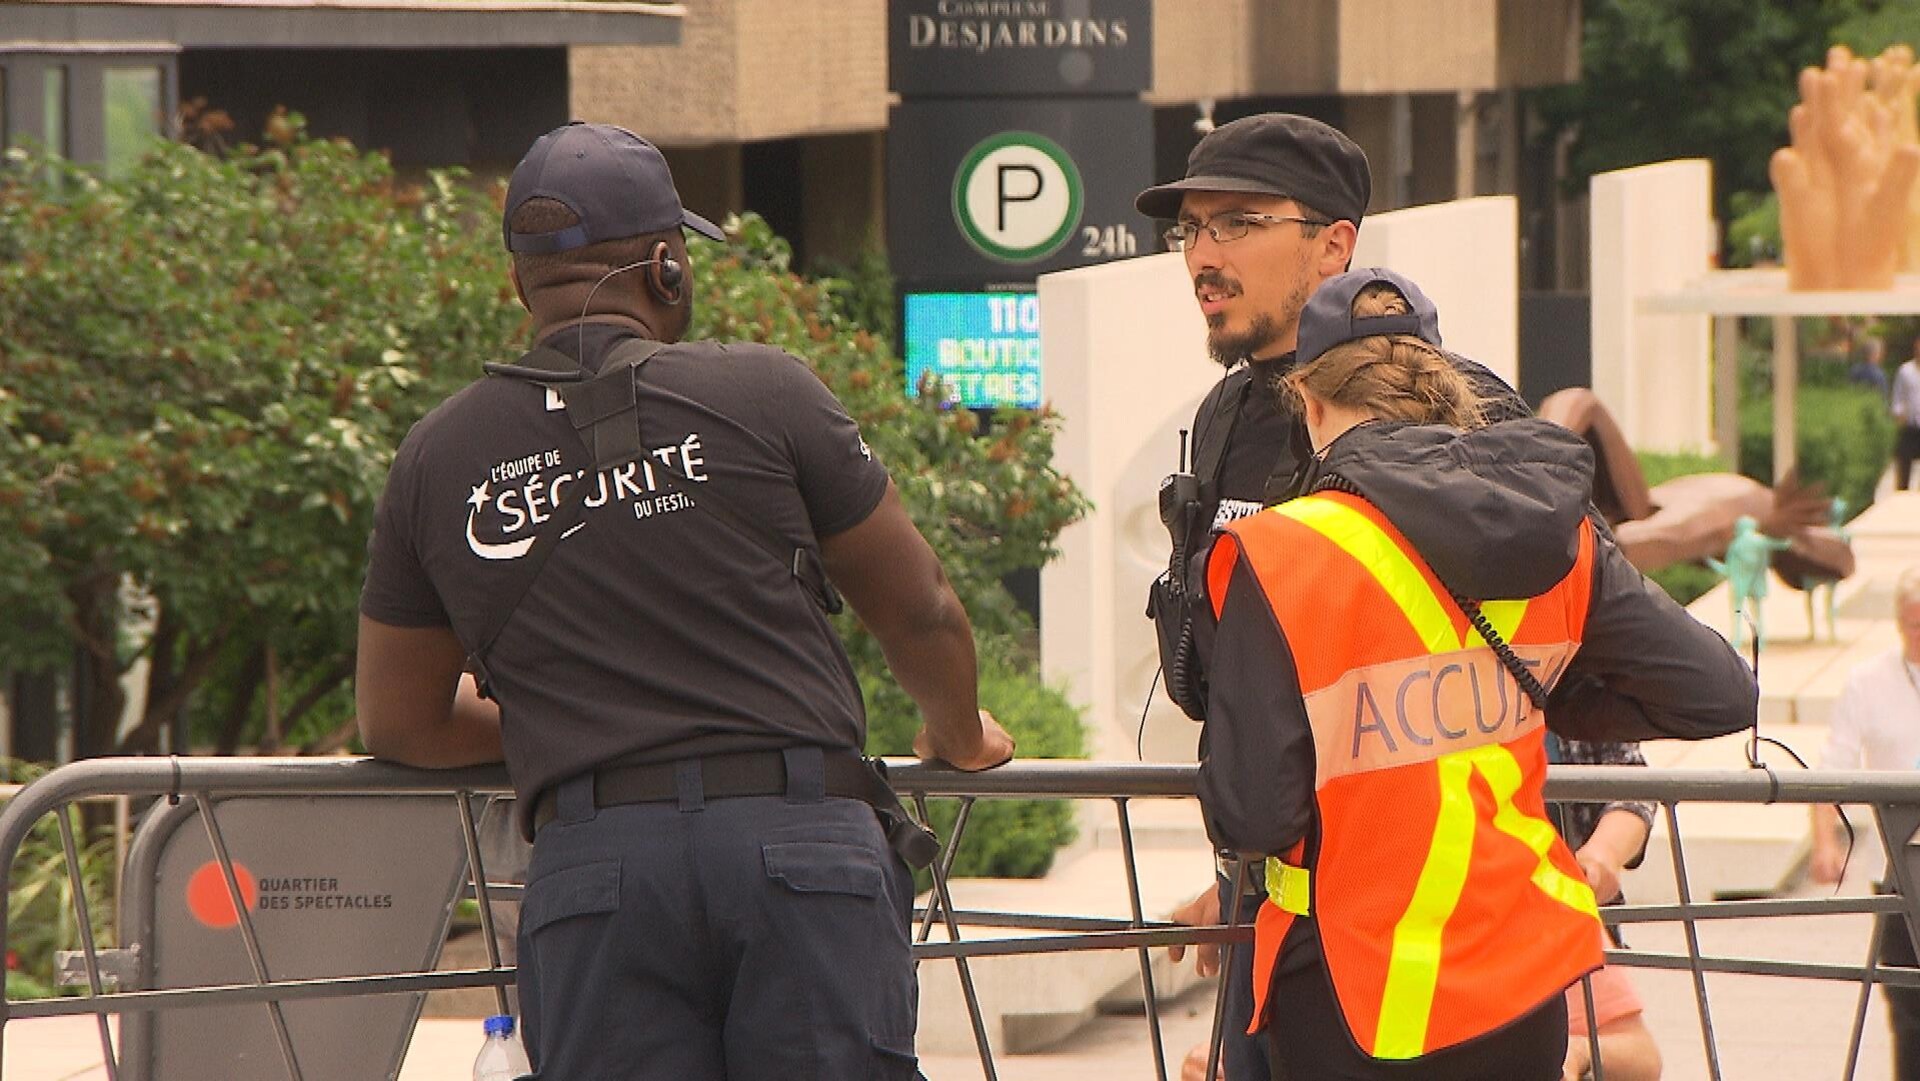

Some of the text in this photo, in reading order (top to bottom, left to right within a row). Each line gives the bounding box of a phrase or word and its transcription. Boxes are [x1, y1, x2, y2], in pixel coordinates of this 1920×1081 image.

[909, 15, 1129, 53] DESJARDINS
[997, 163, 1043, 232] P
[1082, 223, 1137, 257] 24h
[491, 448, 562, 483] L'ÉQUIPE DE
[633, 491, 696, 520] DU FESTI
[259, 878, 338, 892] QUARTIER
[259, 894, 393, 910] DES SPECTACLES
